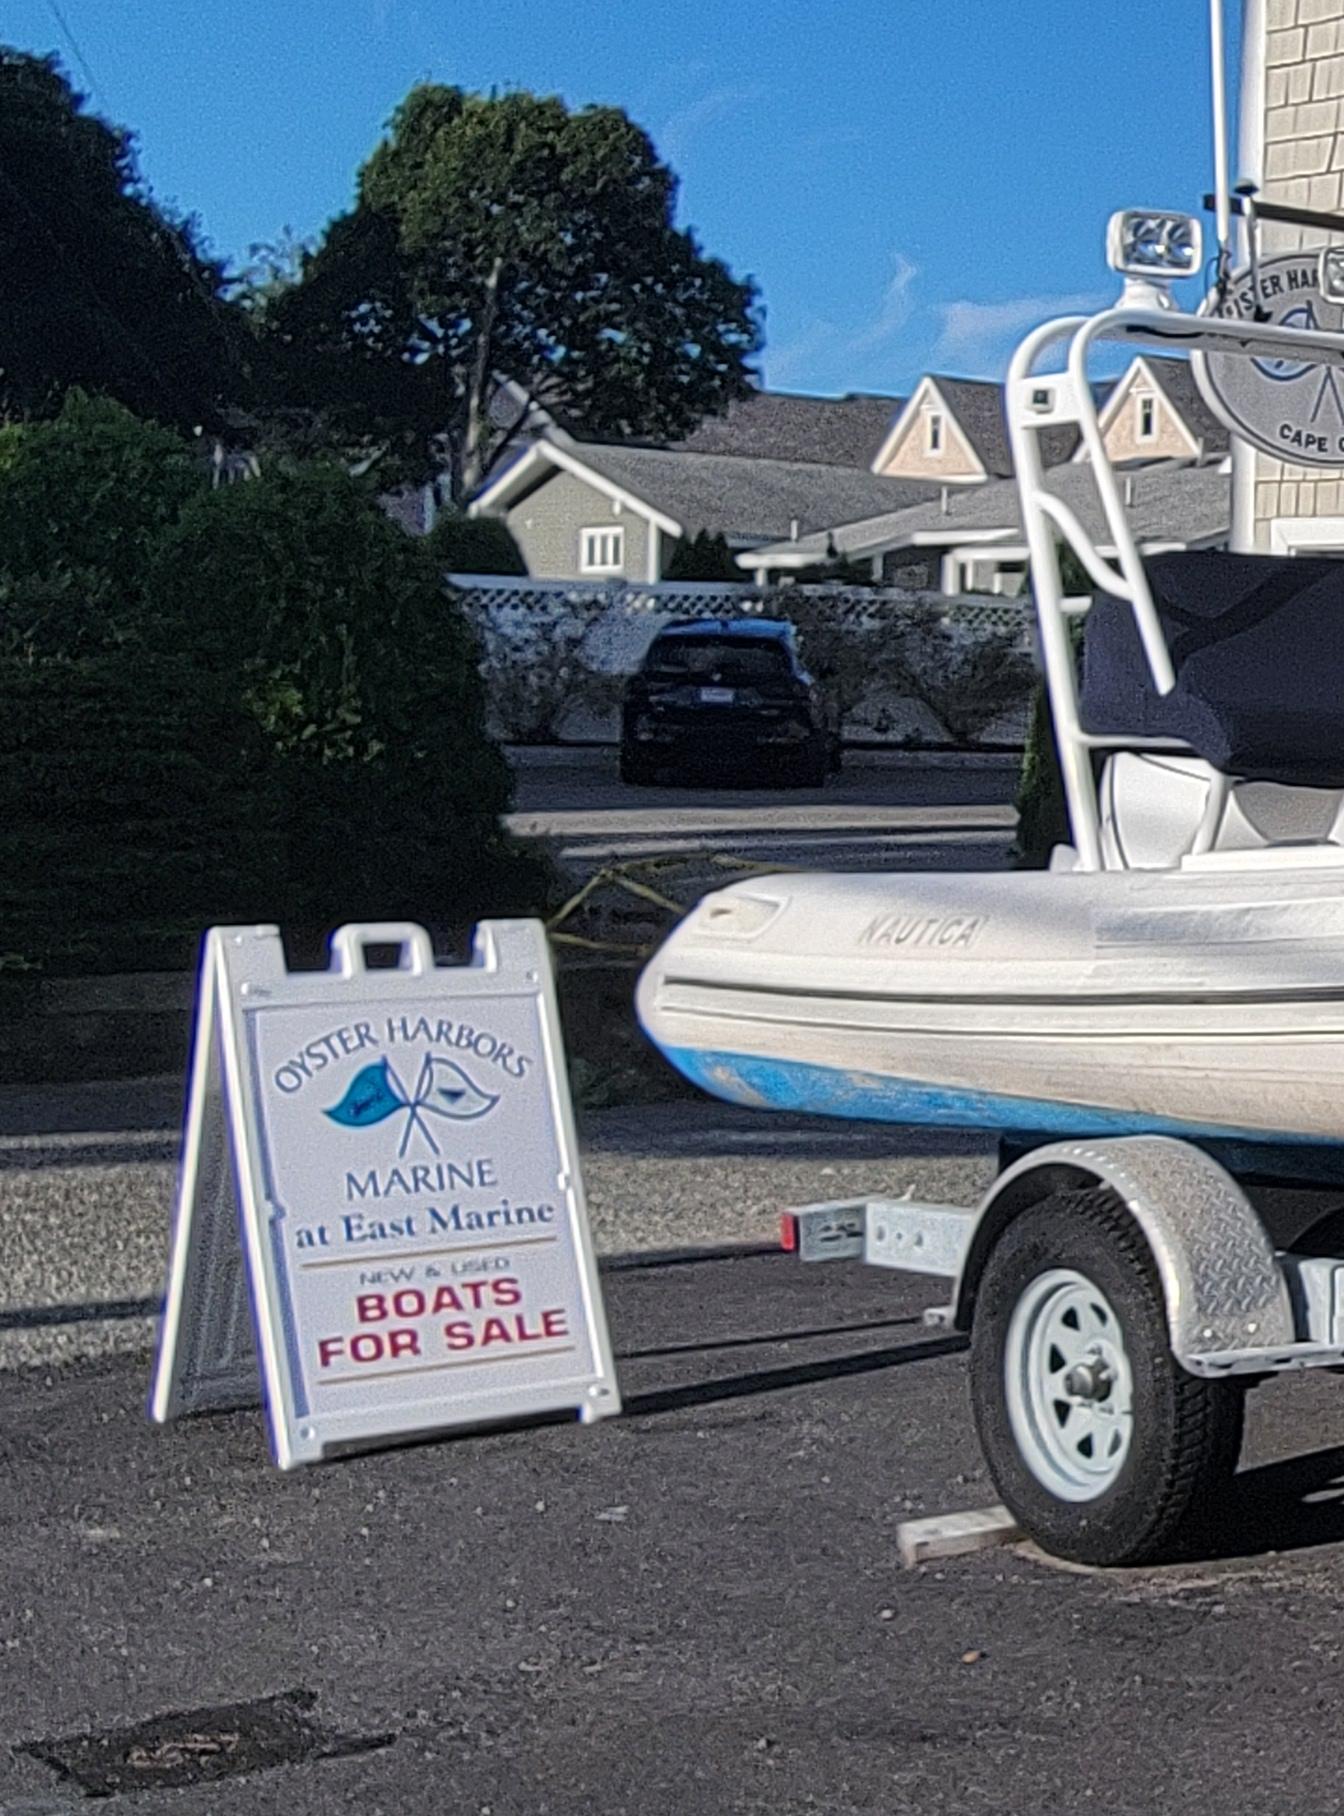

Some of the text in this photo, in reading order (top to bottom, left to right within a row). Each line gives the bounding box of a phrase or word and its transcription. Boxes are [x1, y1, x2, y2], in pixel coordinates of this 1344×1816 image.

[1279, 423, 1328, 453] CAPE
[857, 912, 984, 946] NAUTICA
[274, 1016, 534, 1093] OYSTER HARBORS
[346, 1158, 499, 1201] MARINE
[296, 1199, 555, 1249] at East Marine
[359, 1256, 510, 1285] NEW & USED
[356, 1277, 522, 1323] BOATS
[318, 1308, 570, 1368] FOR SALE
